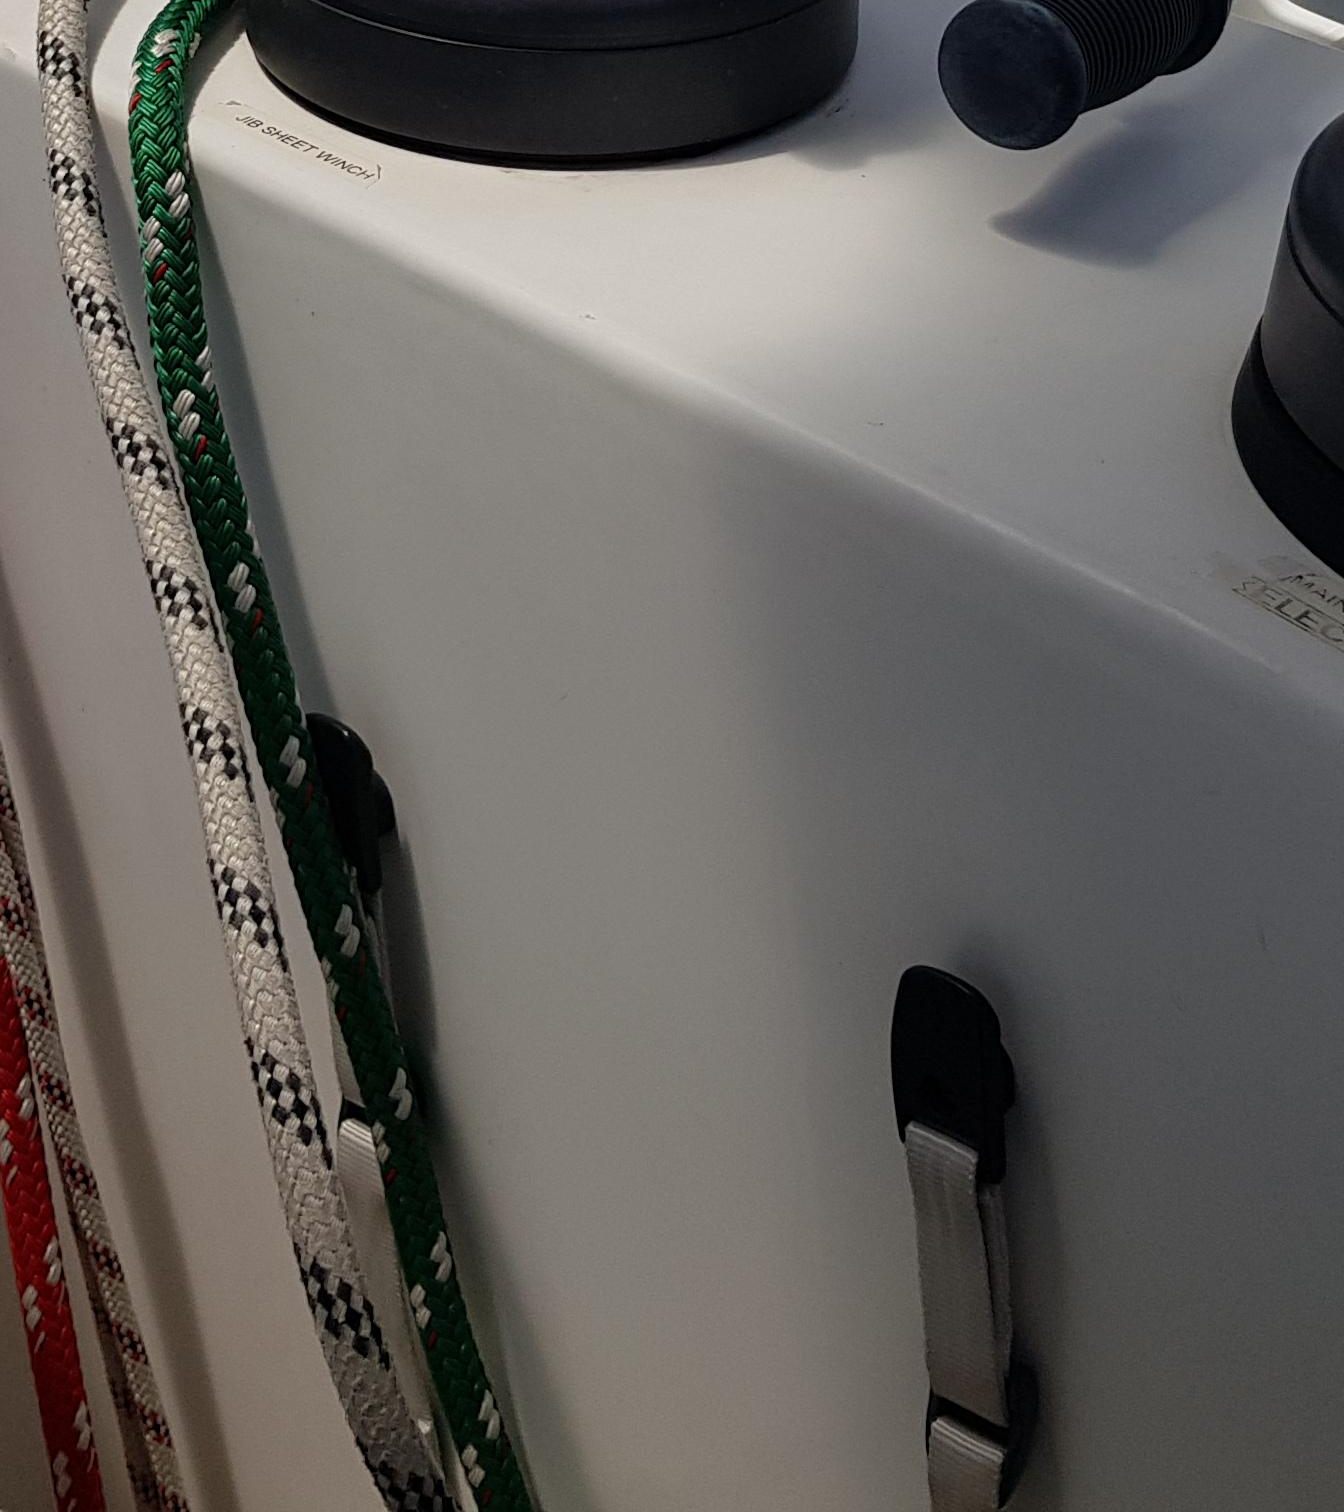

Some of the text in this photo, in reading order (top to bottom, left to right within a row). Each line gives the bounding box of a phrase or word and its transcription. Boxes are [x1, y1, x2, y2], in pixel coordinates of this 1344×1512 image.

[235, 115, 376, 180] JIB SHEET WINCH
